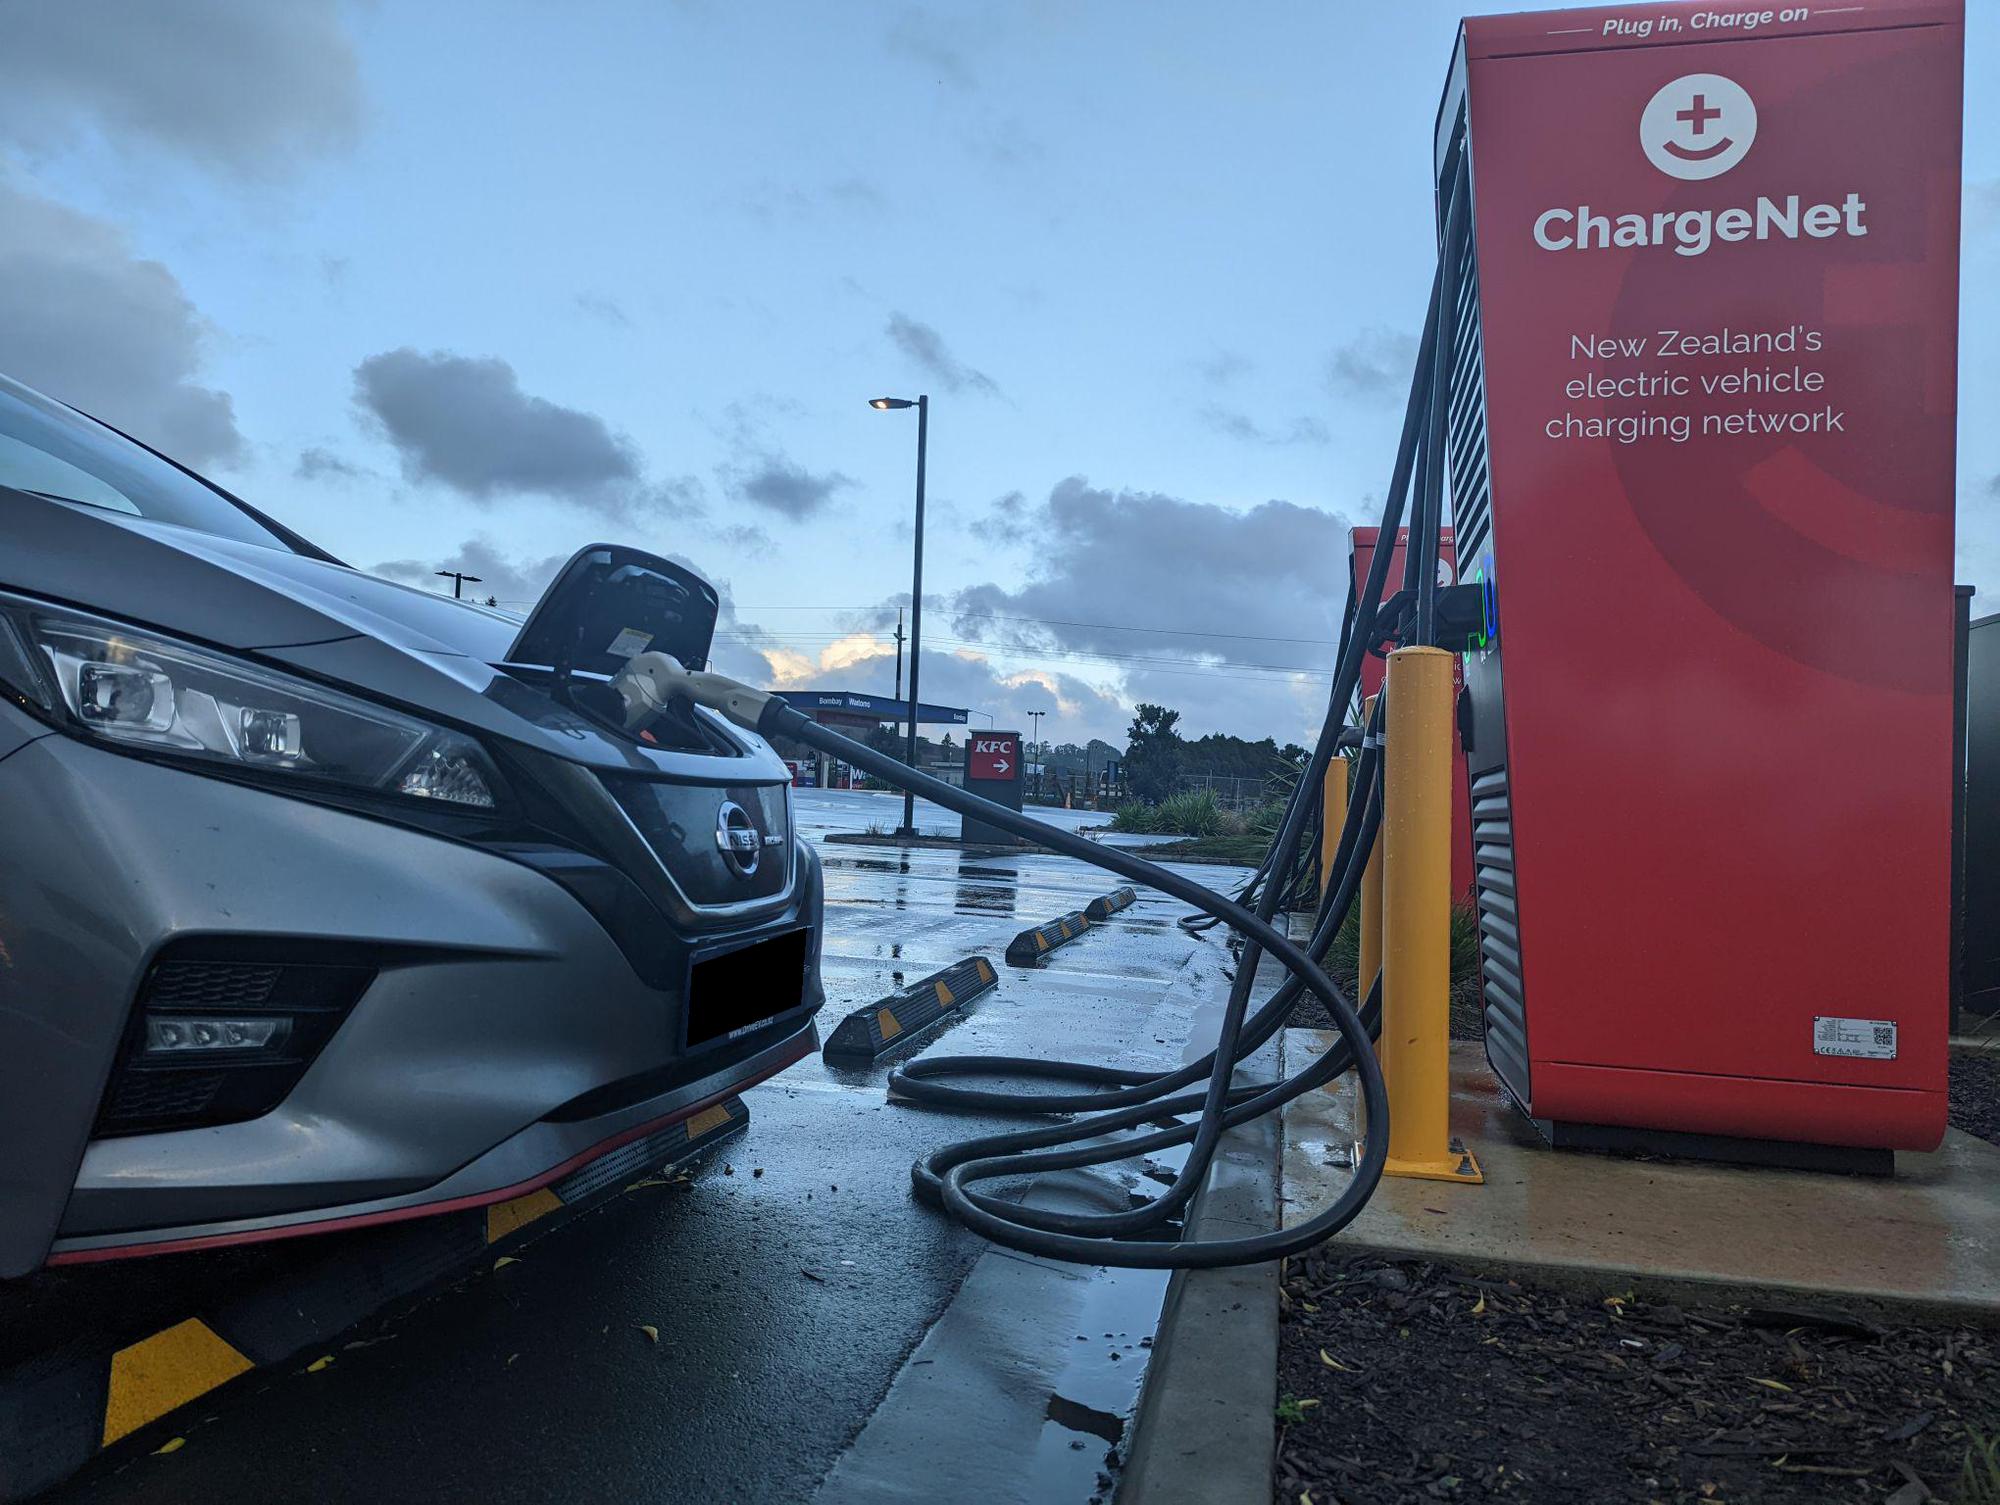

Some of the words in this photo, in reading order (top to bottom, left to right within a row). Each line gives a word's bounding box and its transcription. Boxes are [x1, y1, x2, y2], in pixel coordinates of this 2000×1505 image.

[1602, 18, 1653, 38] Plug
[1658, 15, 1682, 33] in,
[1690, 10, 1774, 30] Charge
[1779, 7, 1809, 22] on
[1533, 192, 1868, 257] ChargeNet
[1571, 334, 1647, 360] New
[1656, 325, 1822, 357] Zealand's
[1565, 370, 1689, 399] electric
[1700, 365, 1825, 394] vehicle
[1545, 410, 1690, 444] charging
[1703, 405, 1844, 435] network
[975, 740, 1012, 754] KFC
